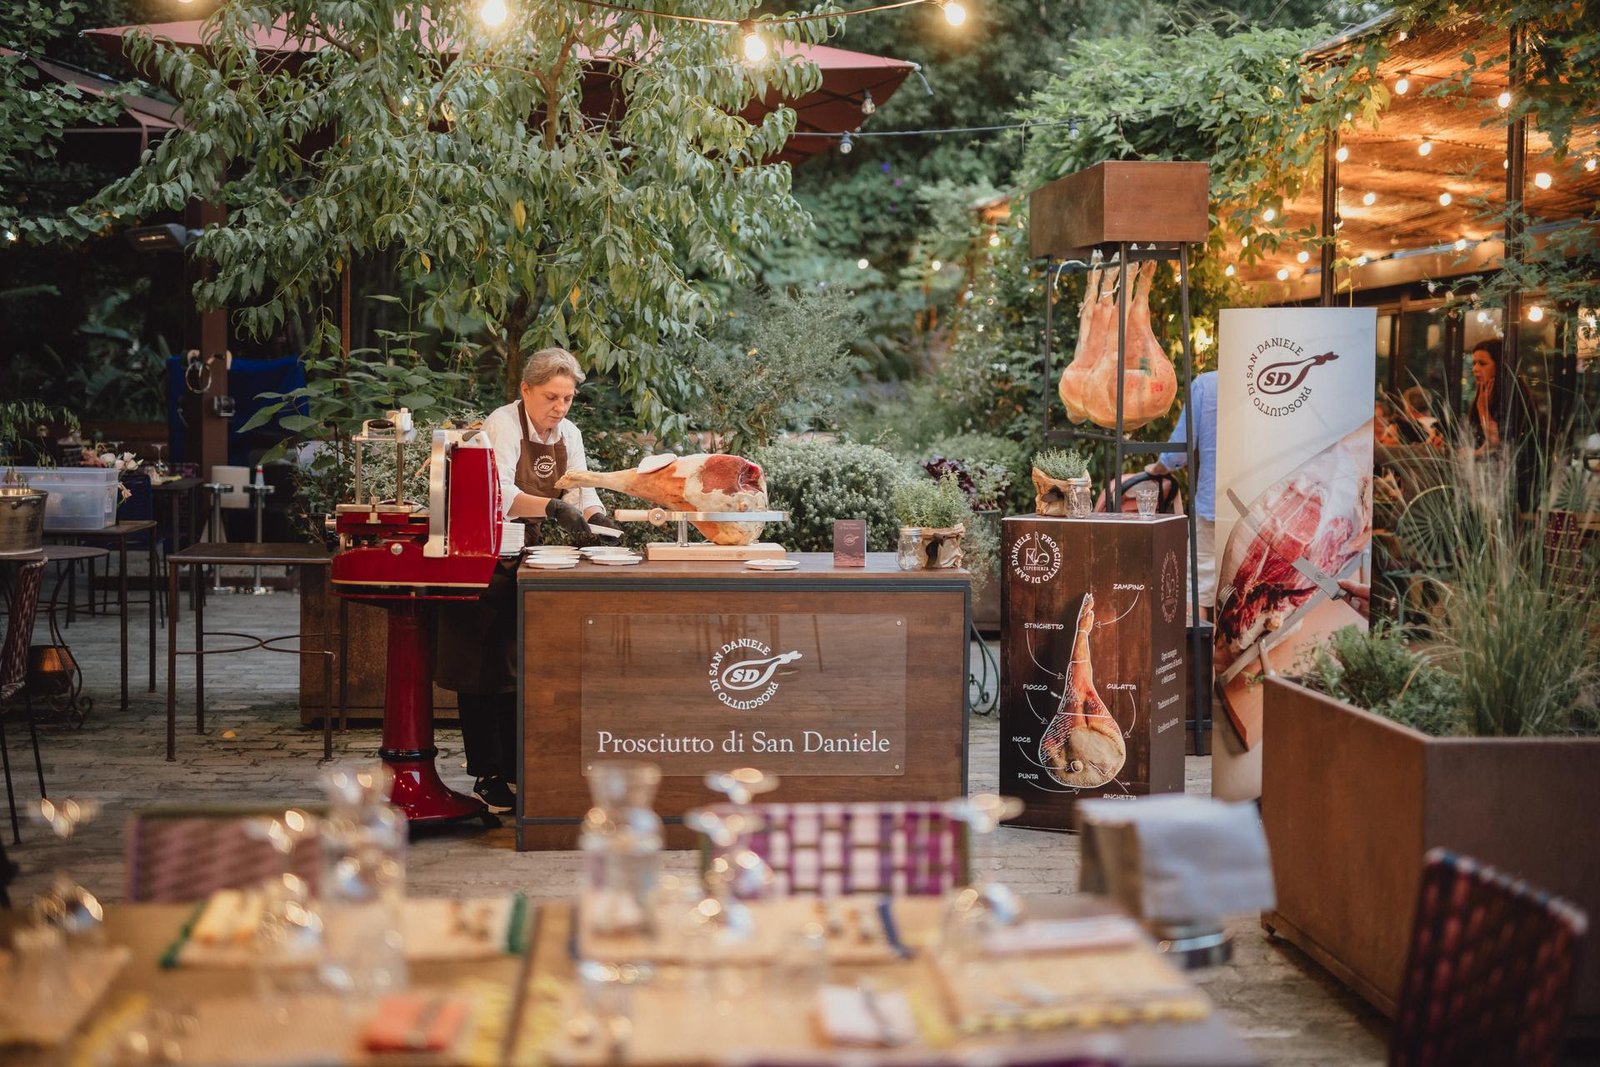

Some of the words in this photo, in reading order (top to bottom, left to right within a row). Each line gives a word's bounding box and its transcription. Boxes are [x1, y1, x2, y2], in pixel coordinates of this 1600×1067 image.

[1256, 337, 1304, 356] DANIELE
[1246, 353, 1258, 379] SAN
[1263, 372, 1292, 386] SD
[1246, 383, 1256, 396] DI
[1253, 386, 1312, 417] PROSCIUTTO
[1011, 533, 1032, 566] DANIELE
[1041, 533, 1061, 582] PROSCIUTTO
[1014, 567, 1031, 582] SAN
[1031, 576, 1042, 584] DI
[1024, 622, 1064, 630] STINCHETTO
[721, 638, 771, 656] DANIELE
[708, 651, 724, 676] SAN
[730, 669, 760, 682] SD
[709, 678, 721, 692] DI
[1022, 683, 1048, 691] FIOCCO
[718, 681, 779, 710] PROSCIUTTO
[597, 730, 714, 753] Prosciutto
[722, 730, 745, 753] di
[751, 730, 795, 753] San
[803, 730, 890, 753] Daniele
[1018, 772, 1039, 780] PUNTA
